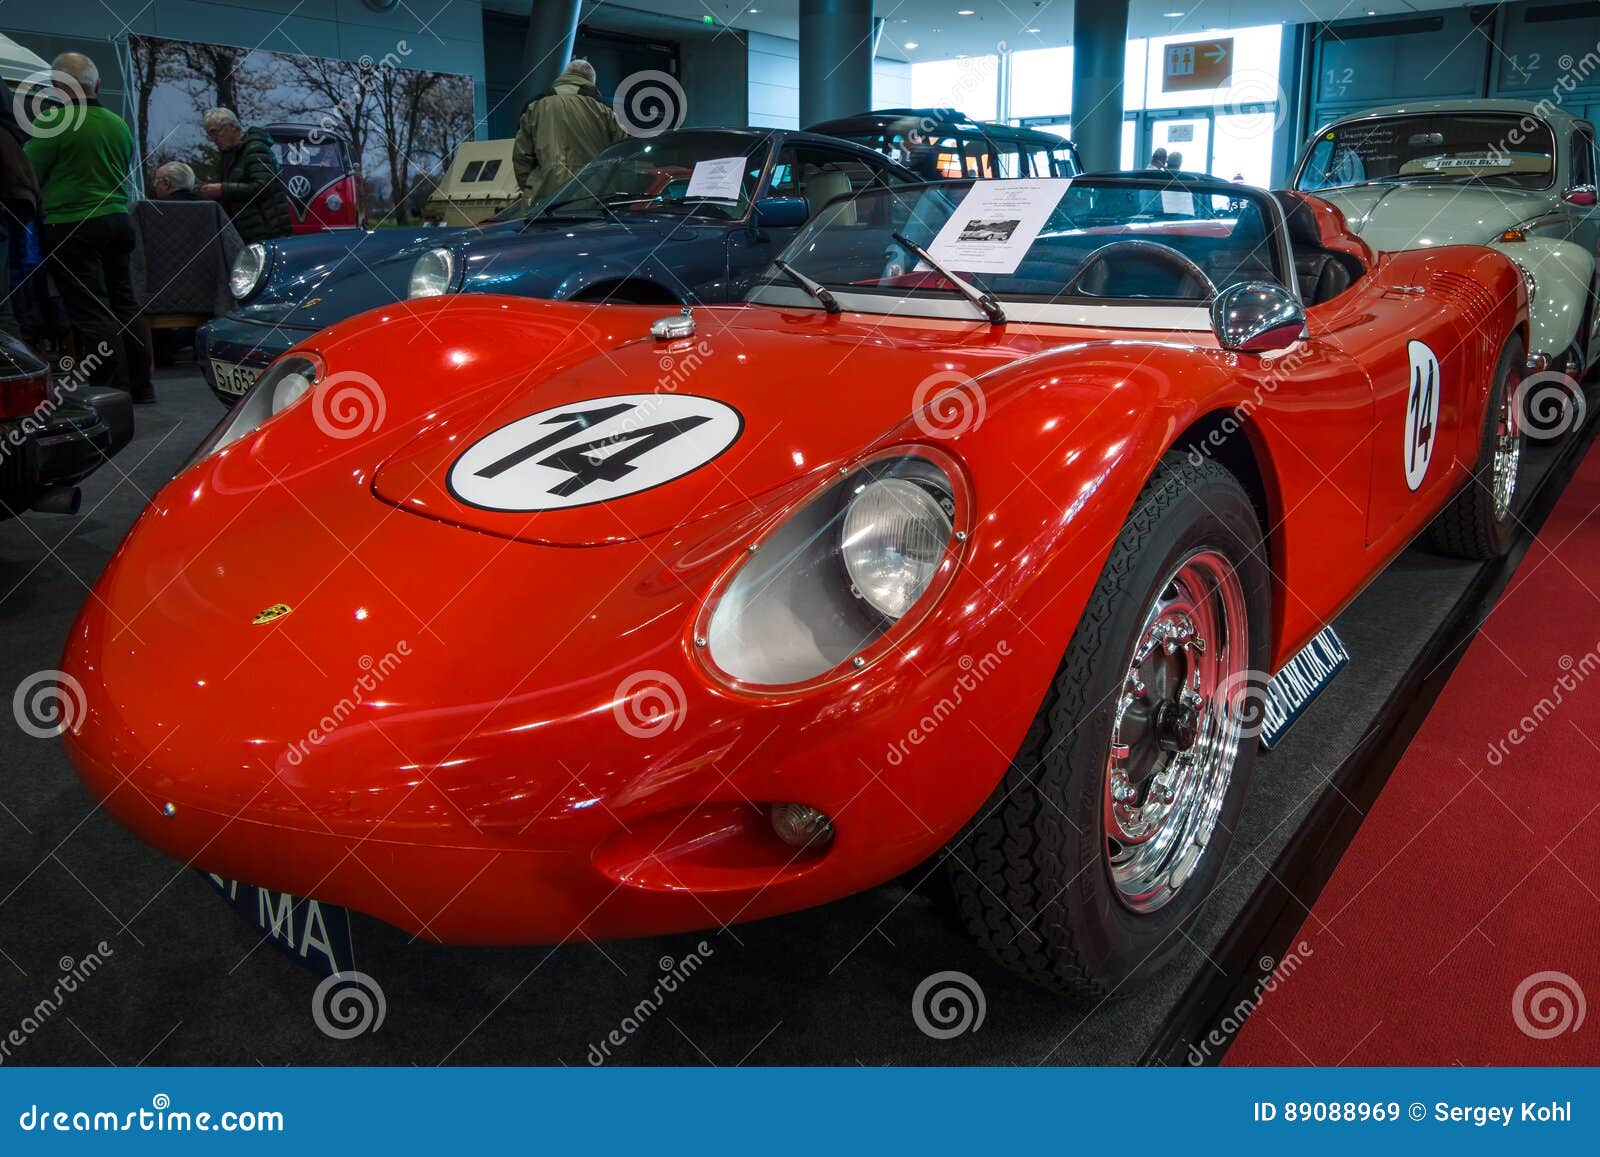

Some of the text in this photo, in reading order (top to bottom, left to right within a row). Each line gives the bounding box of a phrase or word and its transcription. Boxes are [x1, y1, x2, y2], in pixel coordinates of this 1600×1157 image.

[1327, 67, 1354, 84] 1.2
[1510, 52, 1541, 71] 1.2
[1411, 359, 1434, 473] 14
[473, 403, 713, 497] 14
